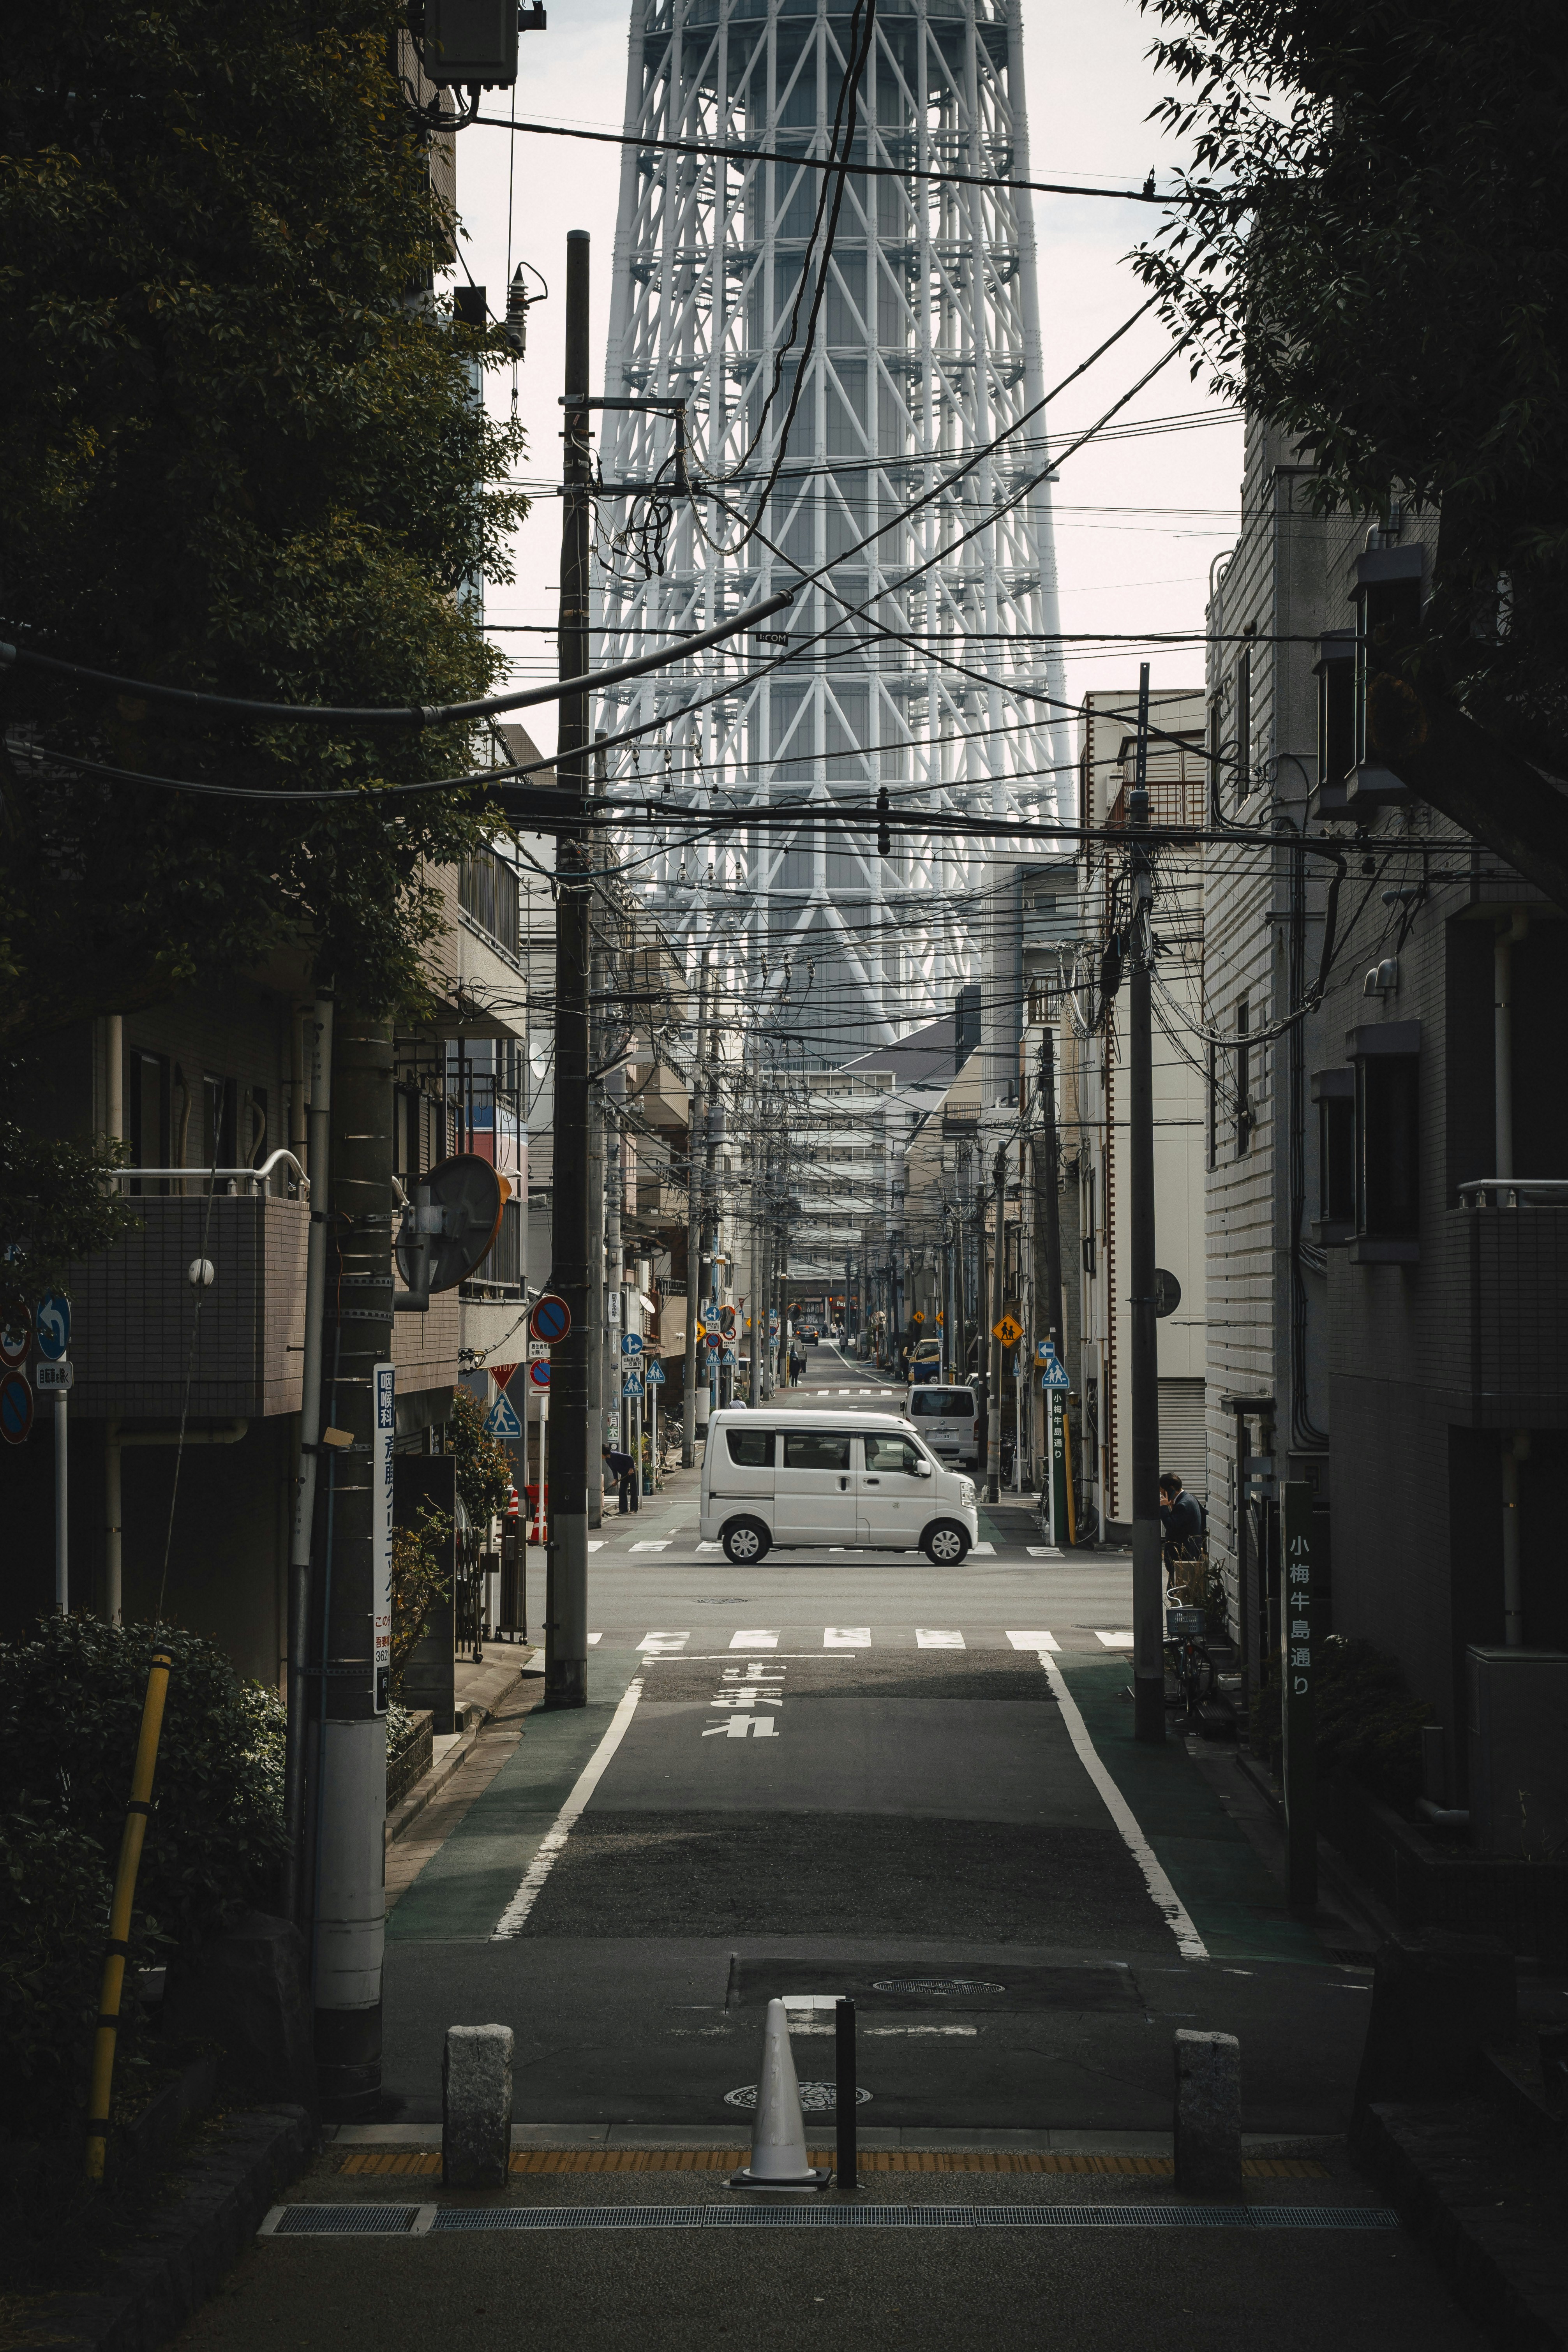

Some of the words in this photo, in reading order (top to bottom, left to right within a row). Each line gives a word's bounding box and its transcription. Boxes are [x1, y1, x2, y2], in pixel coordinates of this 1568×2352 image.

[40, 1368, 69, 1384] 自転車を除く
[1054, 1394, 1062, 1458] 小梅牛島通り
[1290, 1536, 1310, 1694] 小梅牛島通り
[702, 1663, 787, 1738] 止まれ
